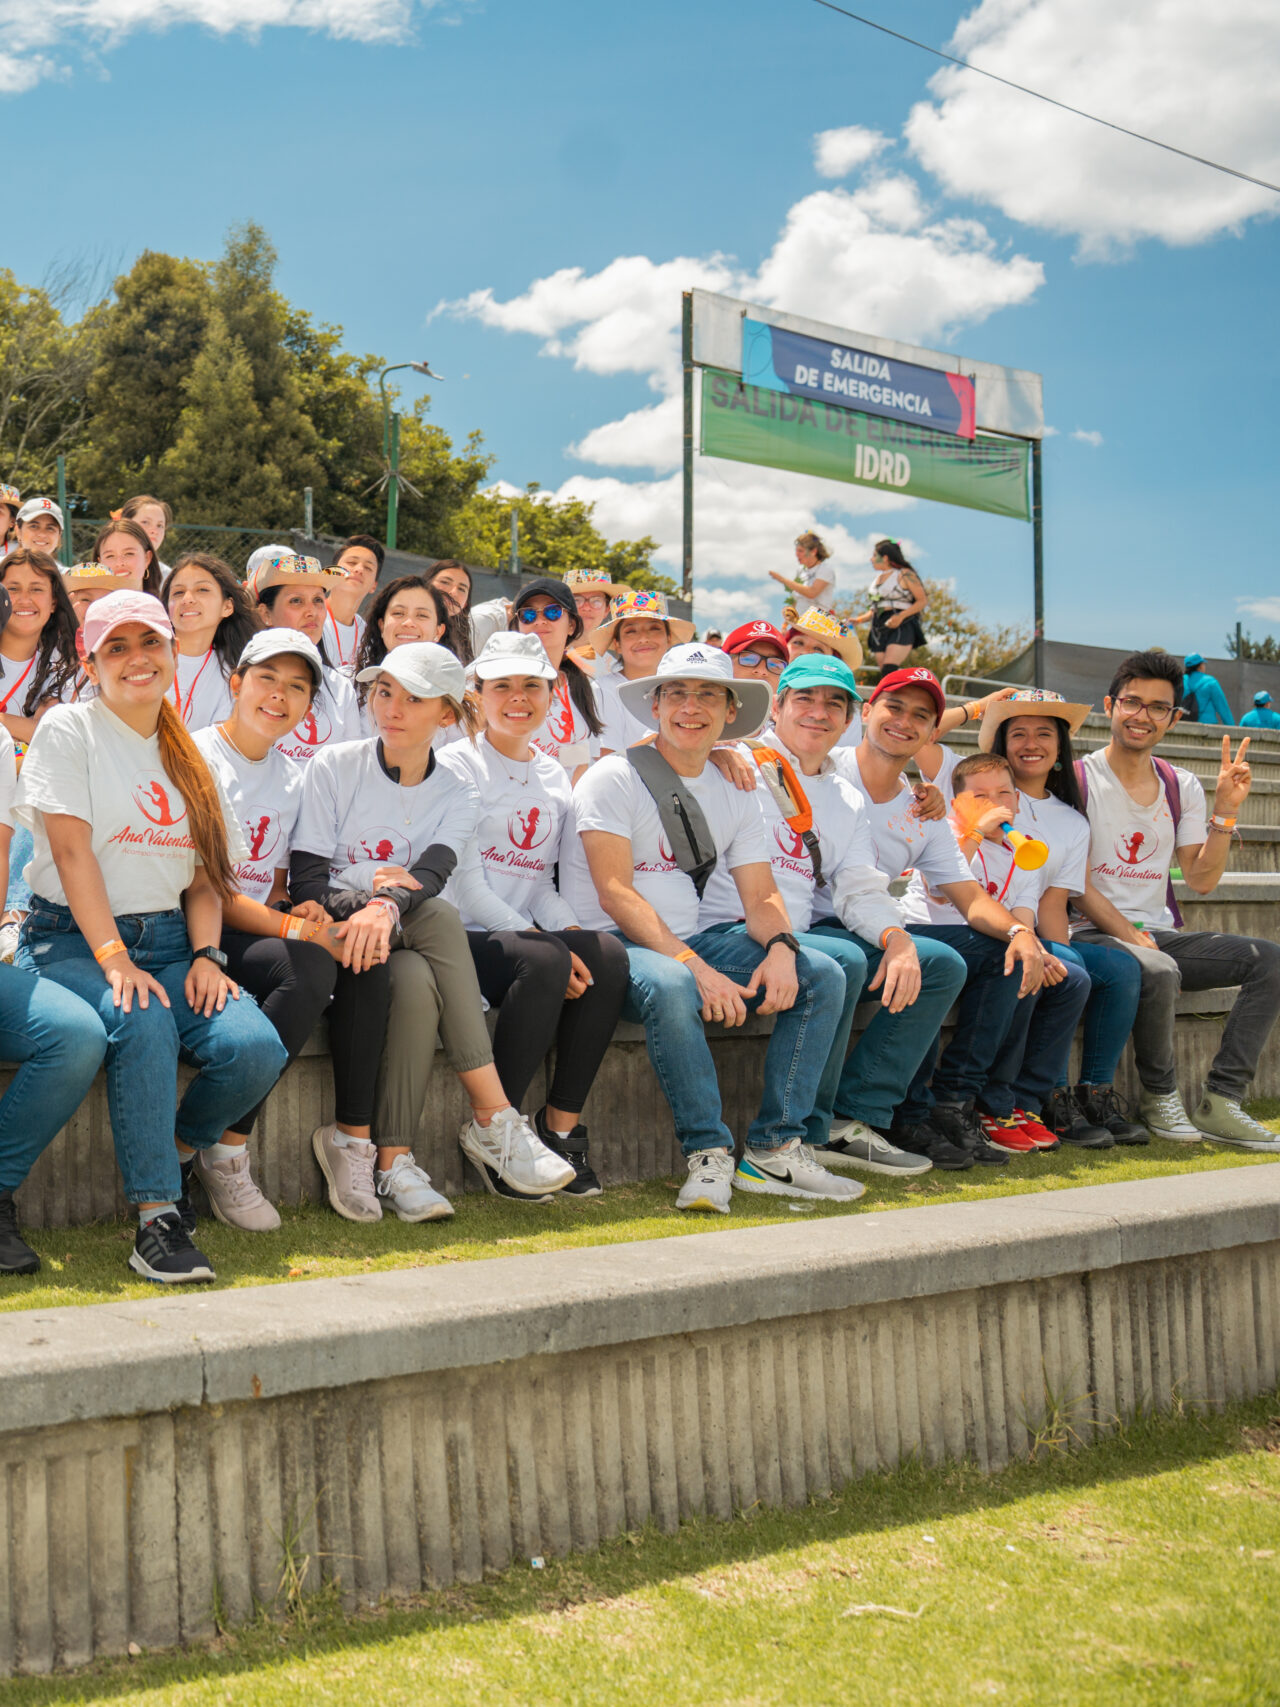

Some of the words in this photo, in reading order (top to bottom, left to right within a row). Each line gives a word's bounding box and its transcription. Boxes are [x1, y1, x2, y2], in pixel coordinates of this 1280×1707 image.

[830, 348, 891, 381] SALIDA
[794, 364, 819, 388] DE
[823, 371, 932, 416] EMERGENCIA
[711, 375, 819, 428] SALIDA
[824, 404, 860, 439] DE
[854, 443, 911, 487] IDRD
[107, 825, 145, 844] Ana
[480, 846, 506, 863] Ana
[1090, 862, 1117, 876] Ana
[1116, 865, 1163, 881] Valentina
